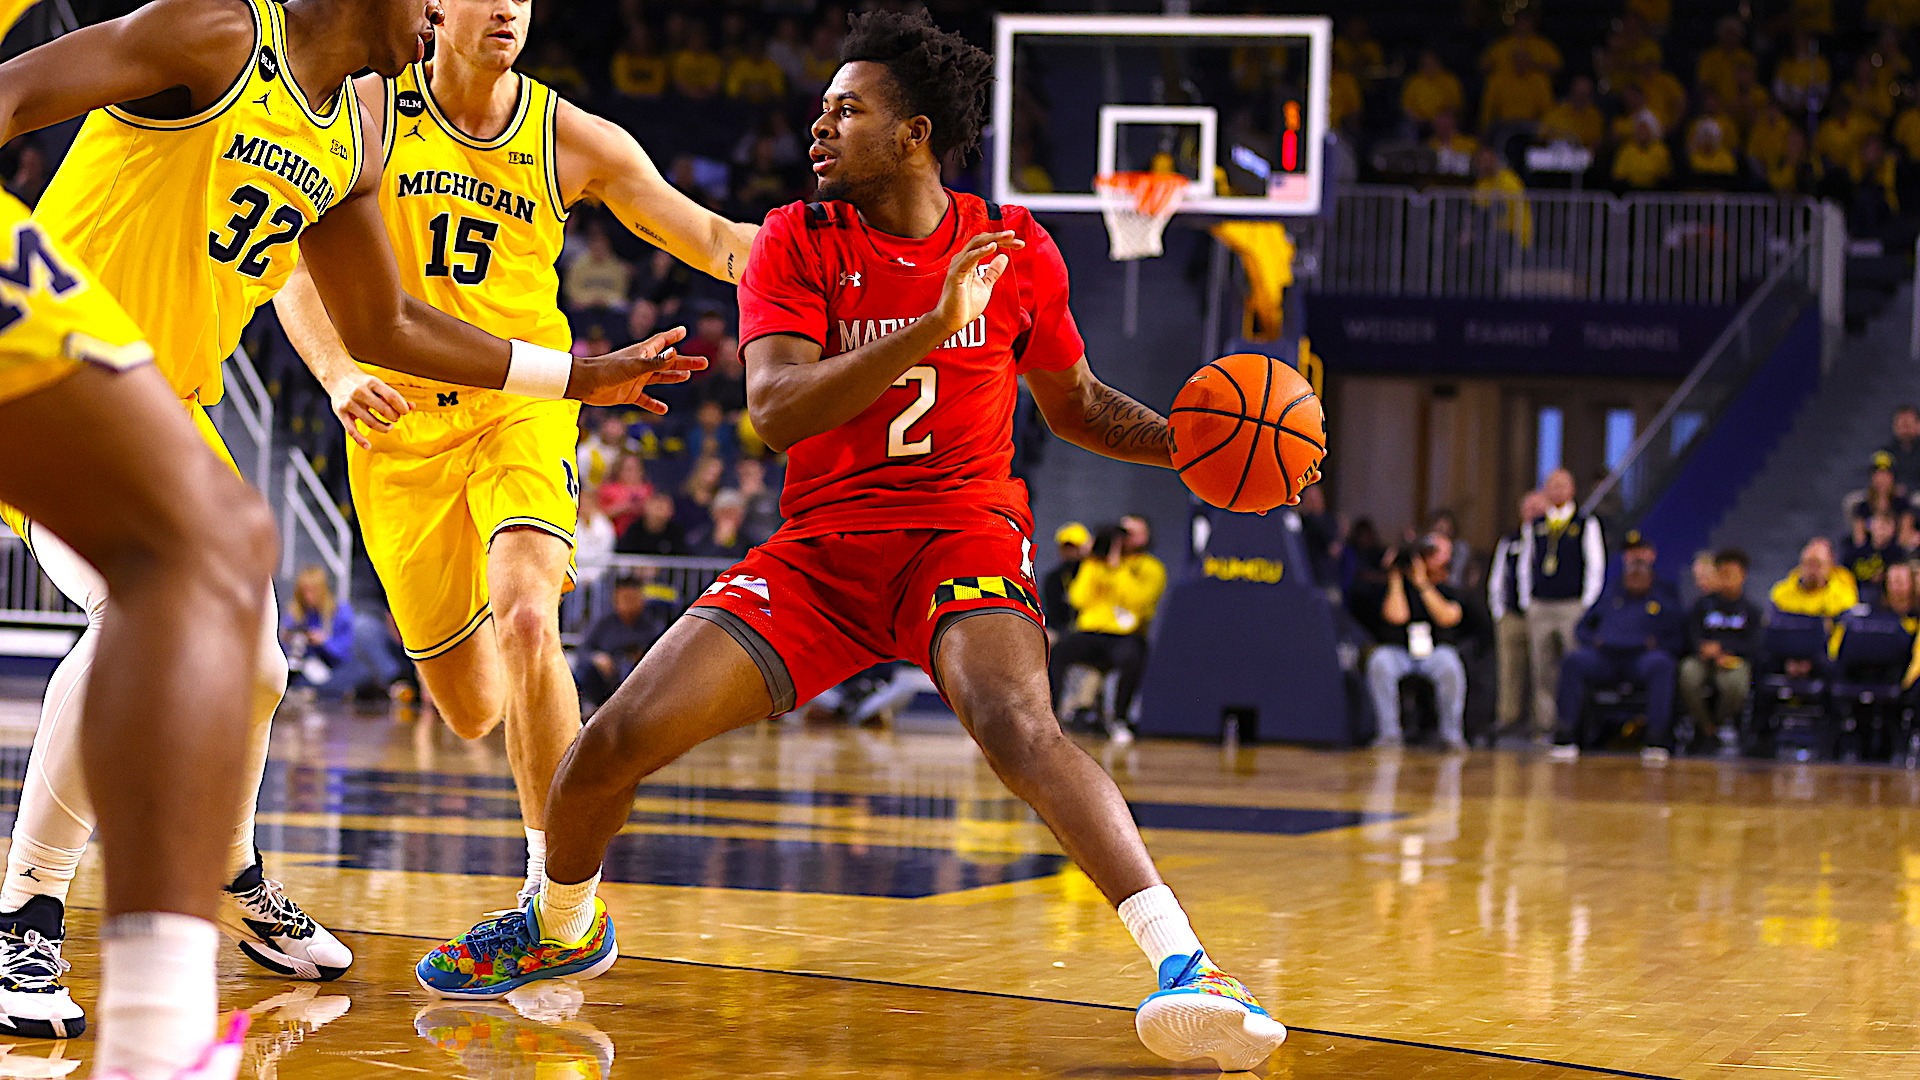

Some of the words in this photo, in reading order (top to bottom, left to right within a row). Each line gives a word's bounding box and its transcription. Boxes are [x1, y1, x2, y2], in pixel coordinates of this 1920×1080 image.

[399, 98, 422, 110] BLM
[221, 132, 337, 217] MICHIGAN
[396, 169, 537, 226] MICHIGAN
[207, 183, 304, 280] 32
[424, 211, 500, 286] 15
[436, 391, 459, 407] M
[887, 364, 938, 459] 2
